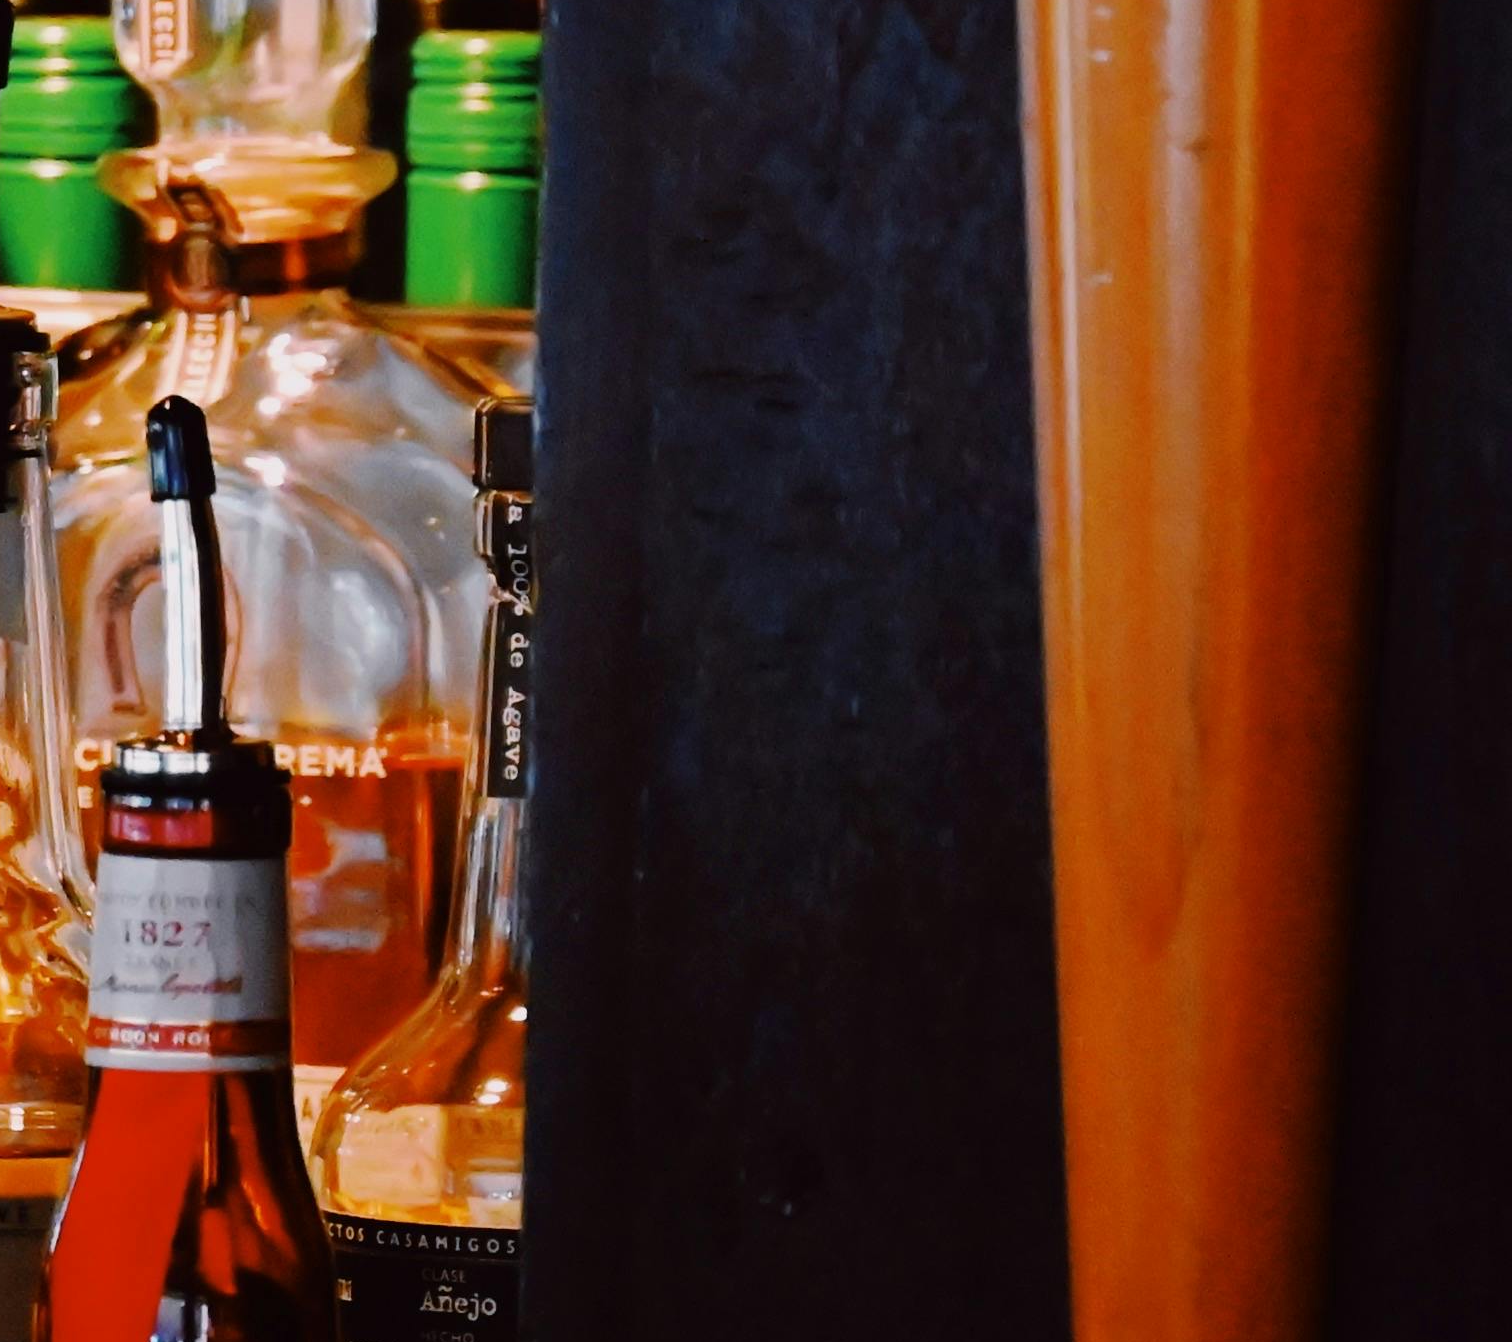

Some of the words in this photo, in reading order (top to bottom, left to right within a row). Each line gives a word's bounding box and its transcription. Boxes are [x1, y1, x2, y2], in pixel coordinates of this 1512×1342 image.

[508, 544, 536, 616] 100%
[510, 632, 530, 668] de
[502, 686, 527, 781] Agave
[274, 743, 388, 778] REMA
[121, 920, 211, 947] 1827
[327, 1221, 364, 1242] CTOS
[376, 1229, 516, 1255] CASAMIGOS
[419, 1286, 496, 1321] Añejo
